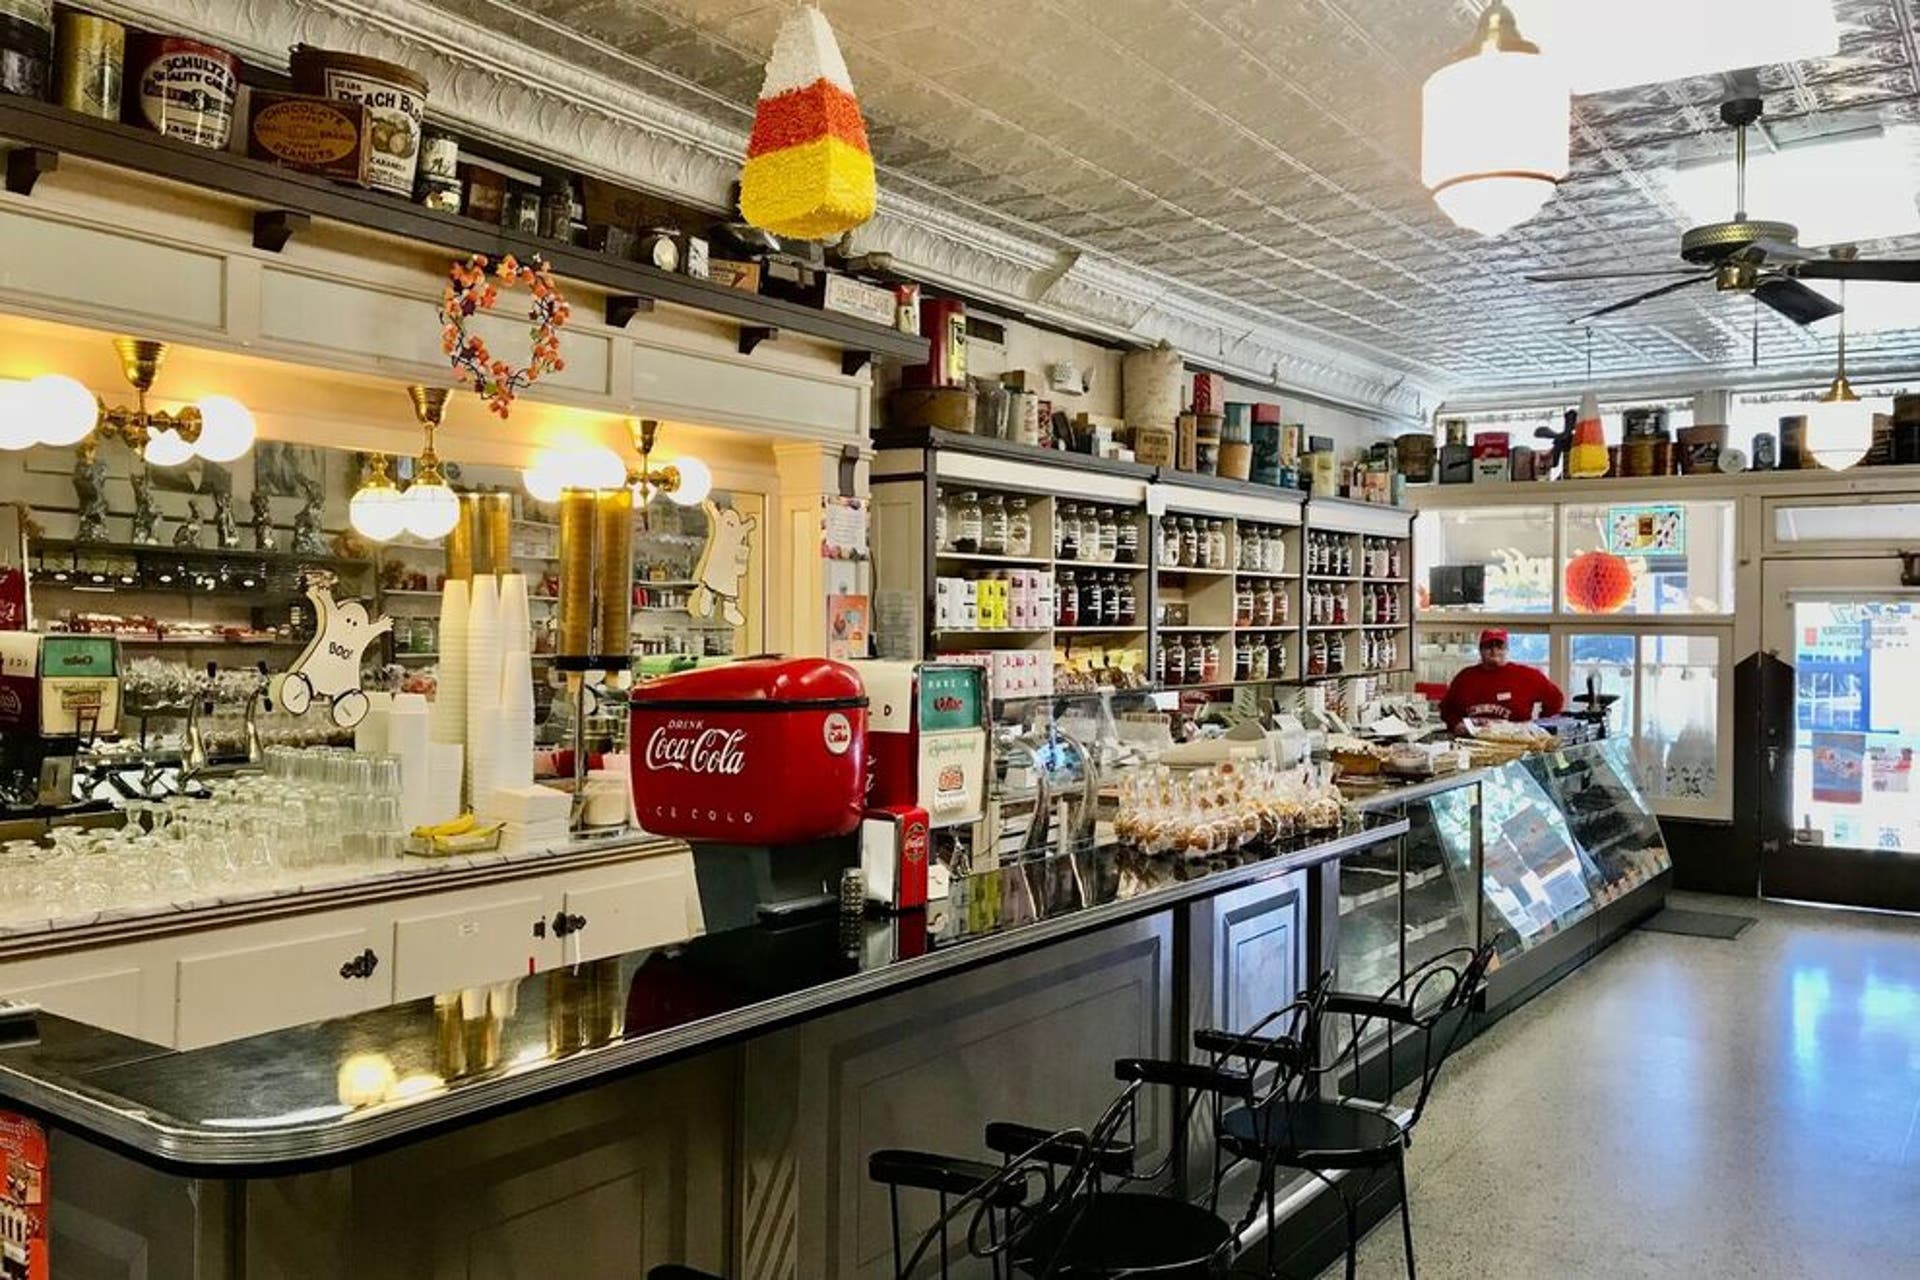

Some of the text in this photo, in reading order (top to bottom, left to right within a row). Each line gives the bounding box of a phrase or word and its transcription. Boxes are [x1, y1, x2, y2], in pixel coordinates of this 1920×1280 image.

[264, 103, 344, 126] CHOCOLATE
[272, 141, 336, 160] PEANUTS
[667, 720, 704, 729] DRINK
[691, 808, 753, 823] COLD
